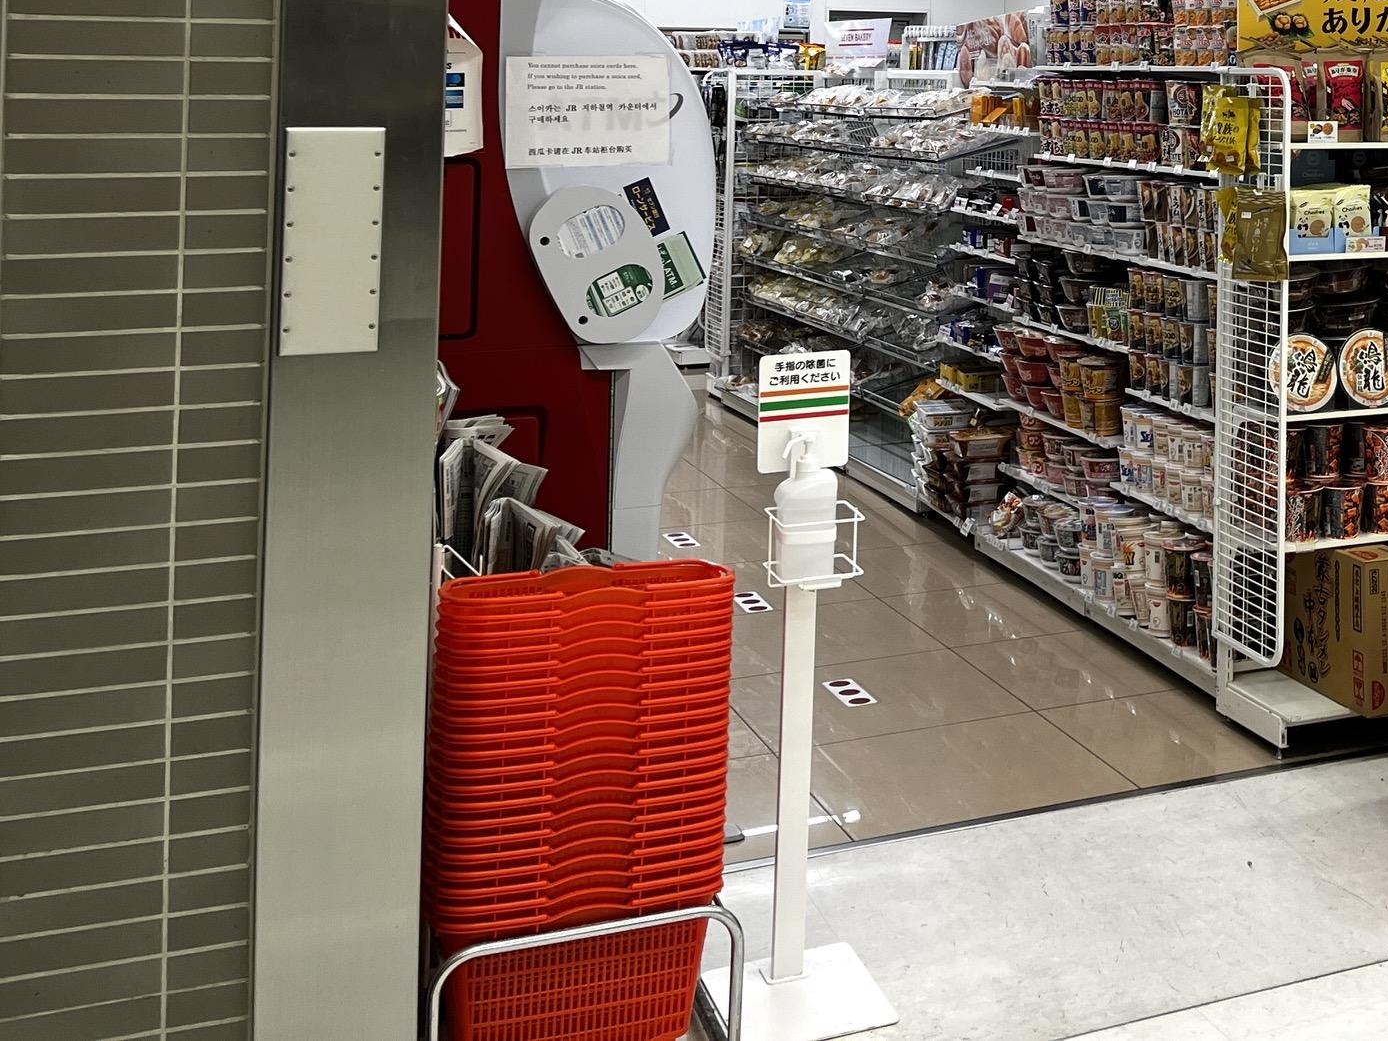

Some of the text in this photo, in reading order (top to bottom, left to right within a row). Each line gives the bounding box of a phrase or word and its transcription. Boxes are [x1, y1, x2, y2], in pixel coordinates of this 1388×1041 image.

[775, 359, 836, 372] 手指の除菌に
[769, 372, 841, 386] ご利用ください
